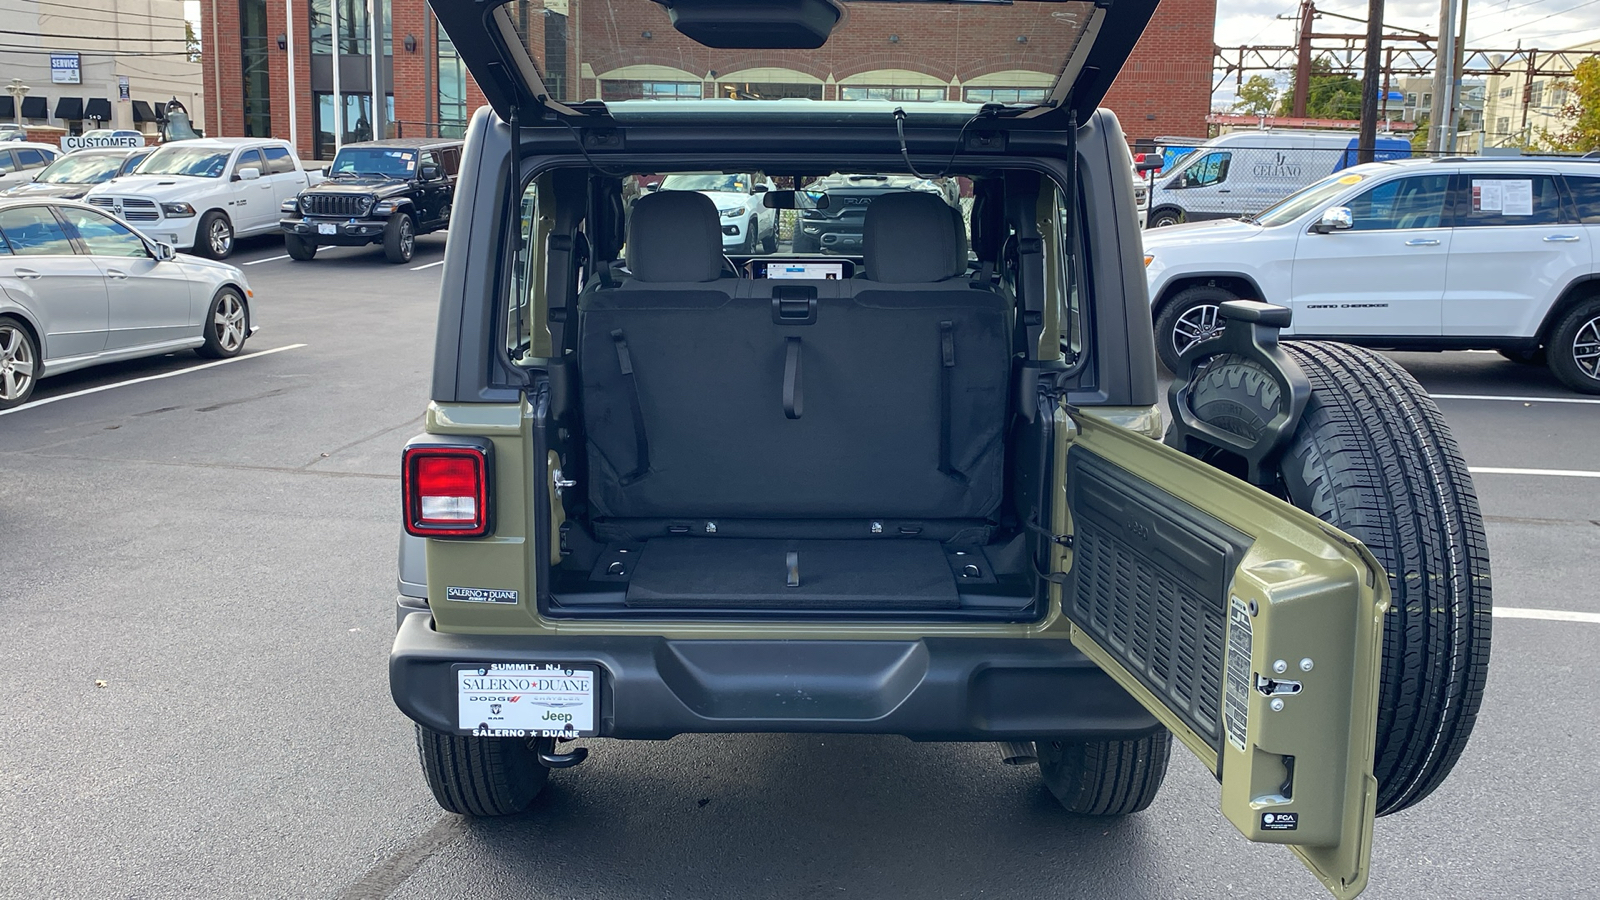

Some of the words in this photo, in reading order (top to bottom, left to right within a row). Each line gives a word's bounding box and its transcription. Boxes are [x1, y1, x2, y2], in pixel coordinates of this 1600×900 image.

[52, 59, 78, 68] SERVICE
[67, 137, 137, 148] CUSTOMER
[1253, 165, 1301, 177] CELIANO
[843, 197, 872, 205] RA
[449, 588, 482, 597] SALERNO
[489, 591, 516, 599] DUANE
[463, 678, 530, 690] SALERNO
[539, 679, 590, 692] DUANE
[541, 711, 572, 723] Jeep
[542, 730, 580, 738] DUANE
